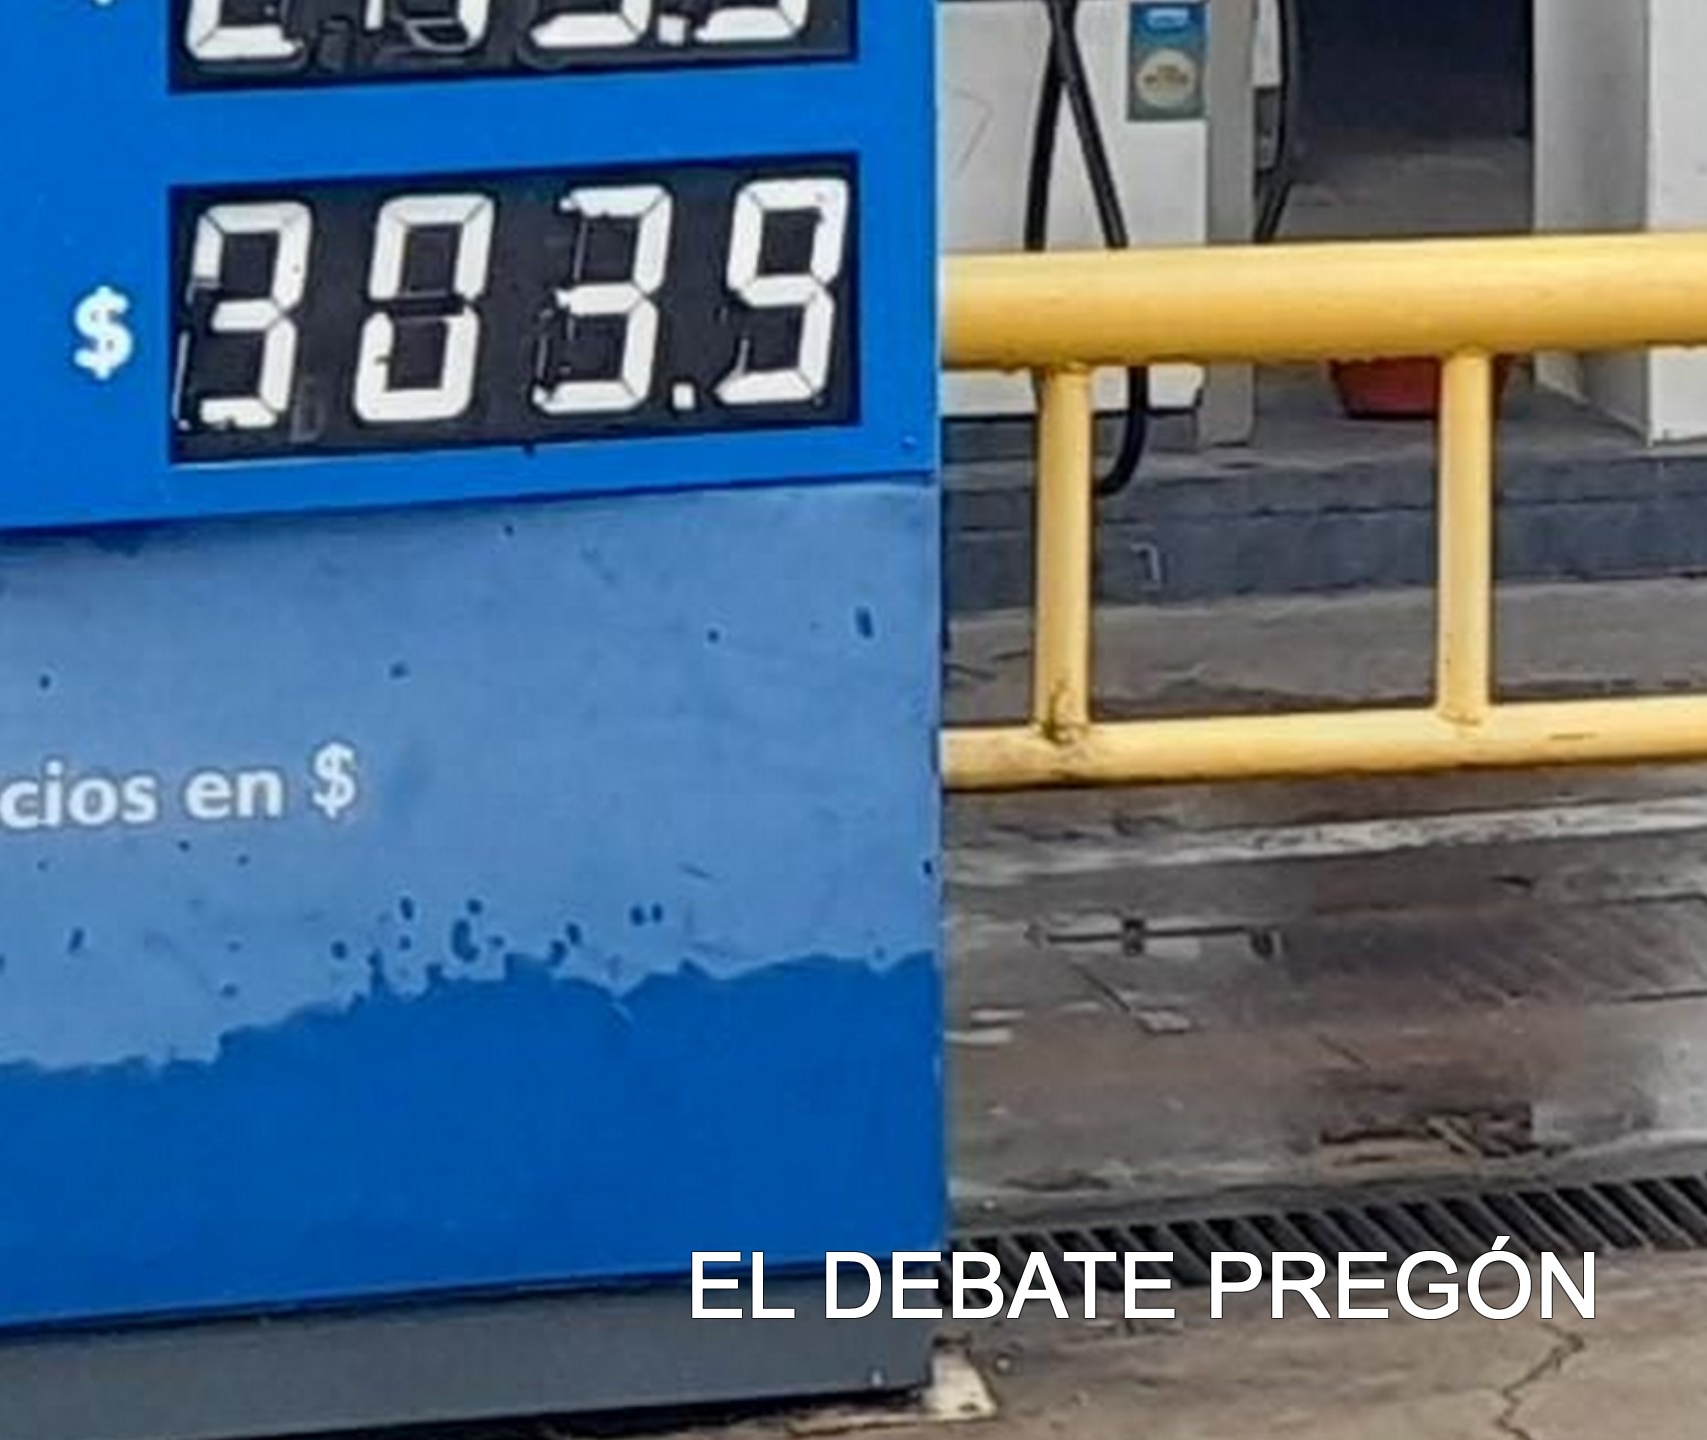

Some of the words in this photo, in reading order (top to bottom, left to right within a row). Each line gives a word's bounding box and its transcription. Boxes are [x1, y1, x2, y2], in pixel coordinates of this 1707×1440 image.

[74, 285, 133, 380] $
[185, 768, 284, 819] en
[312, 742, 355, 817] $
